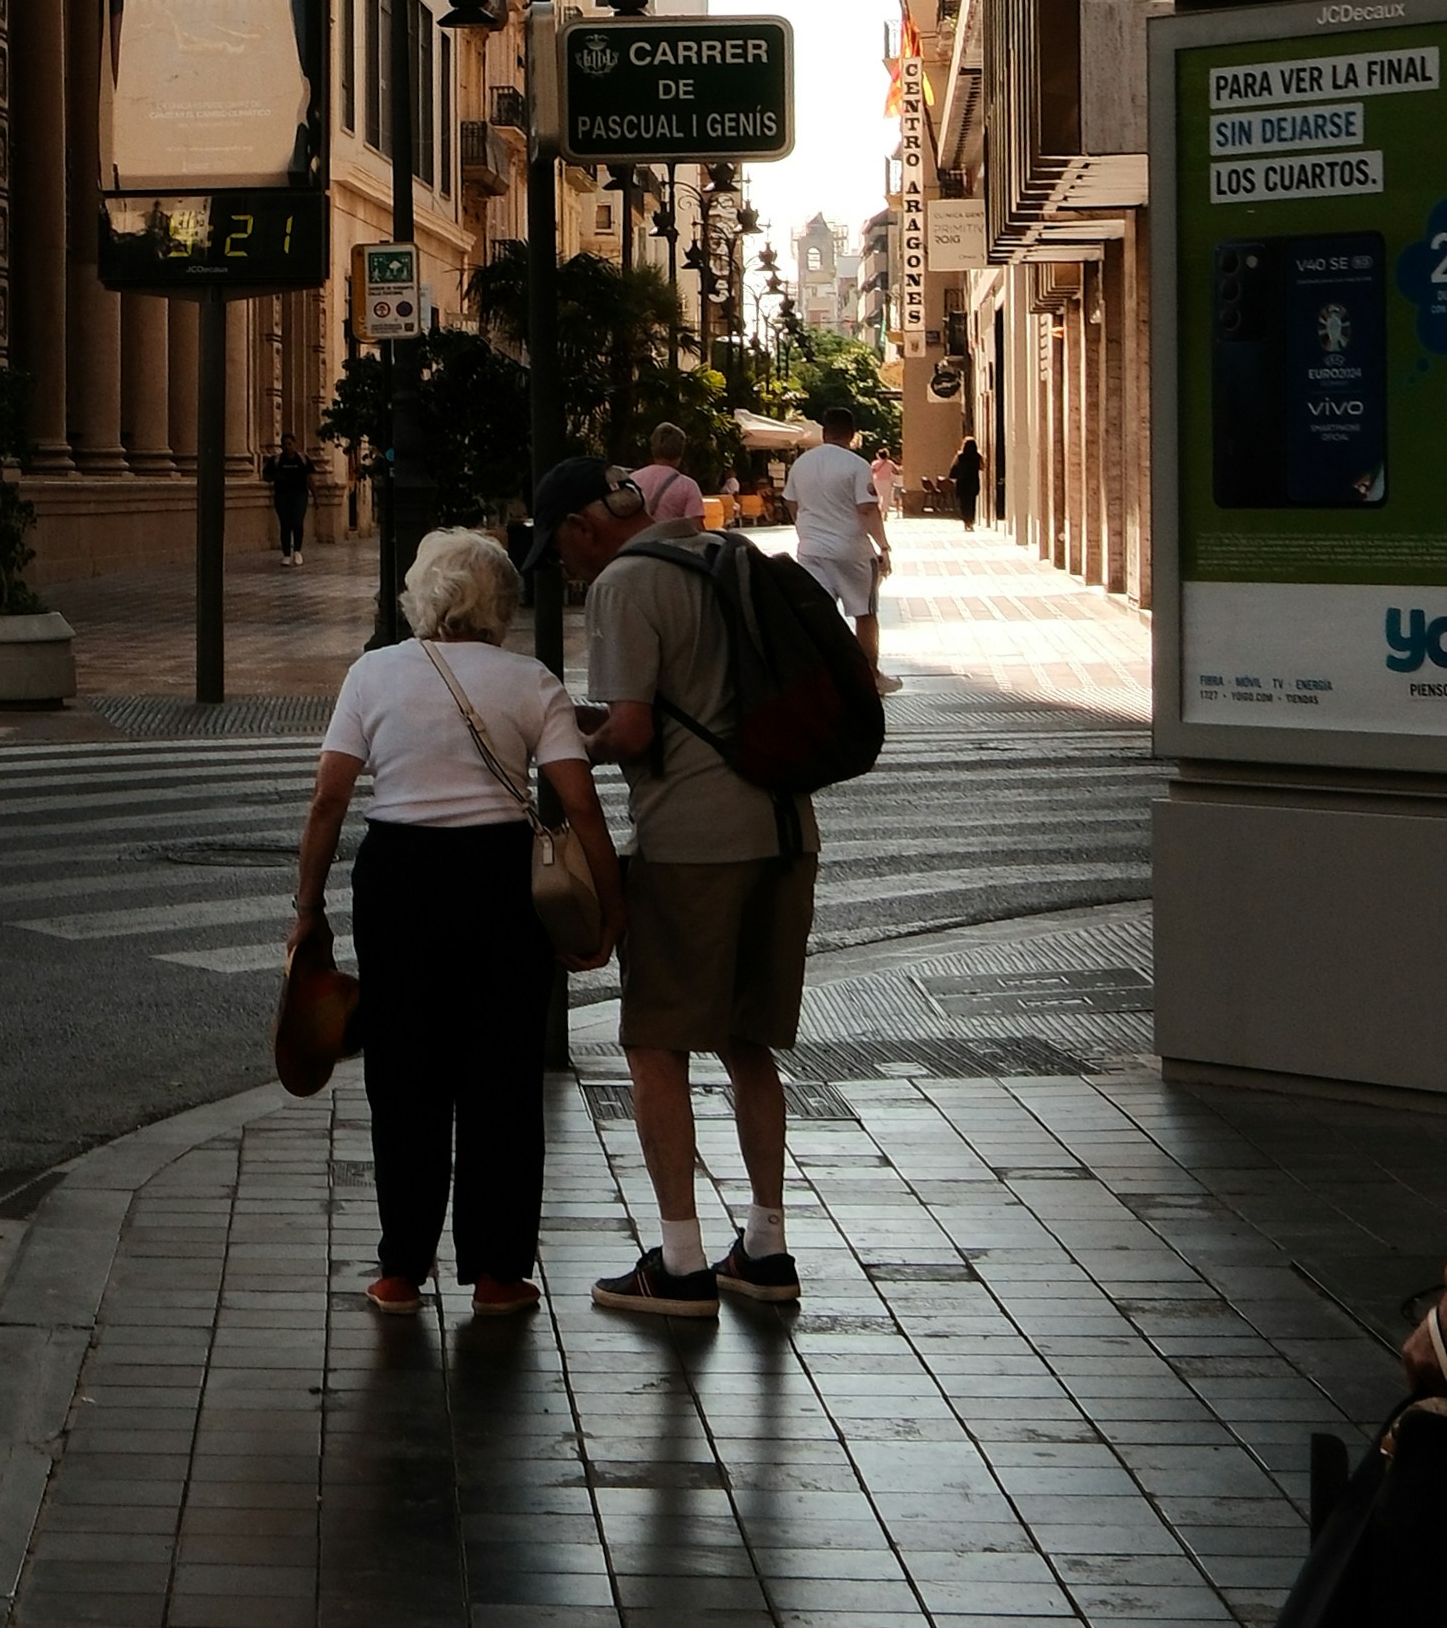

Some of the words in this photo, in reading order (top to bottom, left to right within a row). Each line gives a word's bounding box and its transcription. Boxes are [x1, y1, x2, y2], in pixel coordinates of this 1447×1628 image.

[1316, 1, 1407, 26] JCDecaux
[629, 39, 769, 66] CARRER
[658, 79, 695, 100] DE
[1214, 70, 1273, 102] PARA
[1280, 65, 1323, 95] VER
[1332, 61, 1360, 91] LA
[1367, 54, 1433, 87] FINAL
[577, 113, 684, 139] PASCUAL
[692, 114, 698, 138] I
[707, 105, 778, 138] GENÍS
[903, 62, 922, 168] CENTRO
[1215, 120, 1252, 148] SIN
[1261, 111, 1357, 144] DEJARSE
[1215, 168, 1256, 196] LOS
[1264, 158, 1377, 193] CUARTOS.
[903, 180, 923, 325] ARAGONES
[933, 234, 961, 245] ROIG
[1296, 258, 1326, 272] V40
[1329, 257, 1349, 270] SE
[1307, 397, 1364, 416] vivo
[1272, 677, 1284, 690] TV
[1286, 693, 1320, 705] TIENDAS
